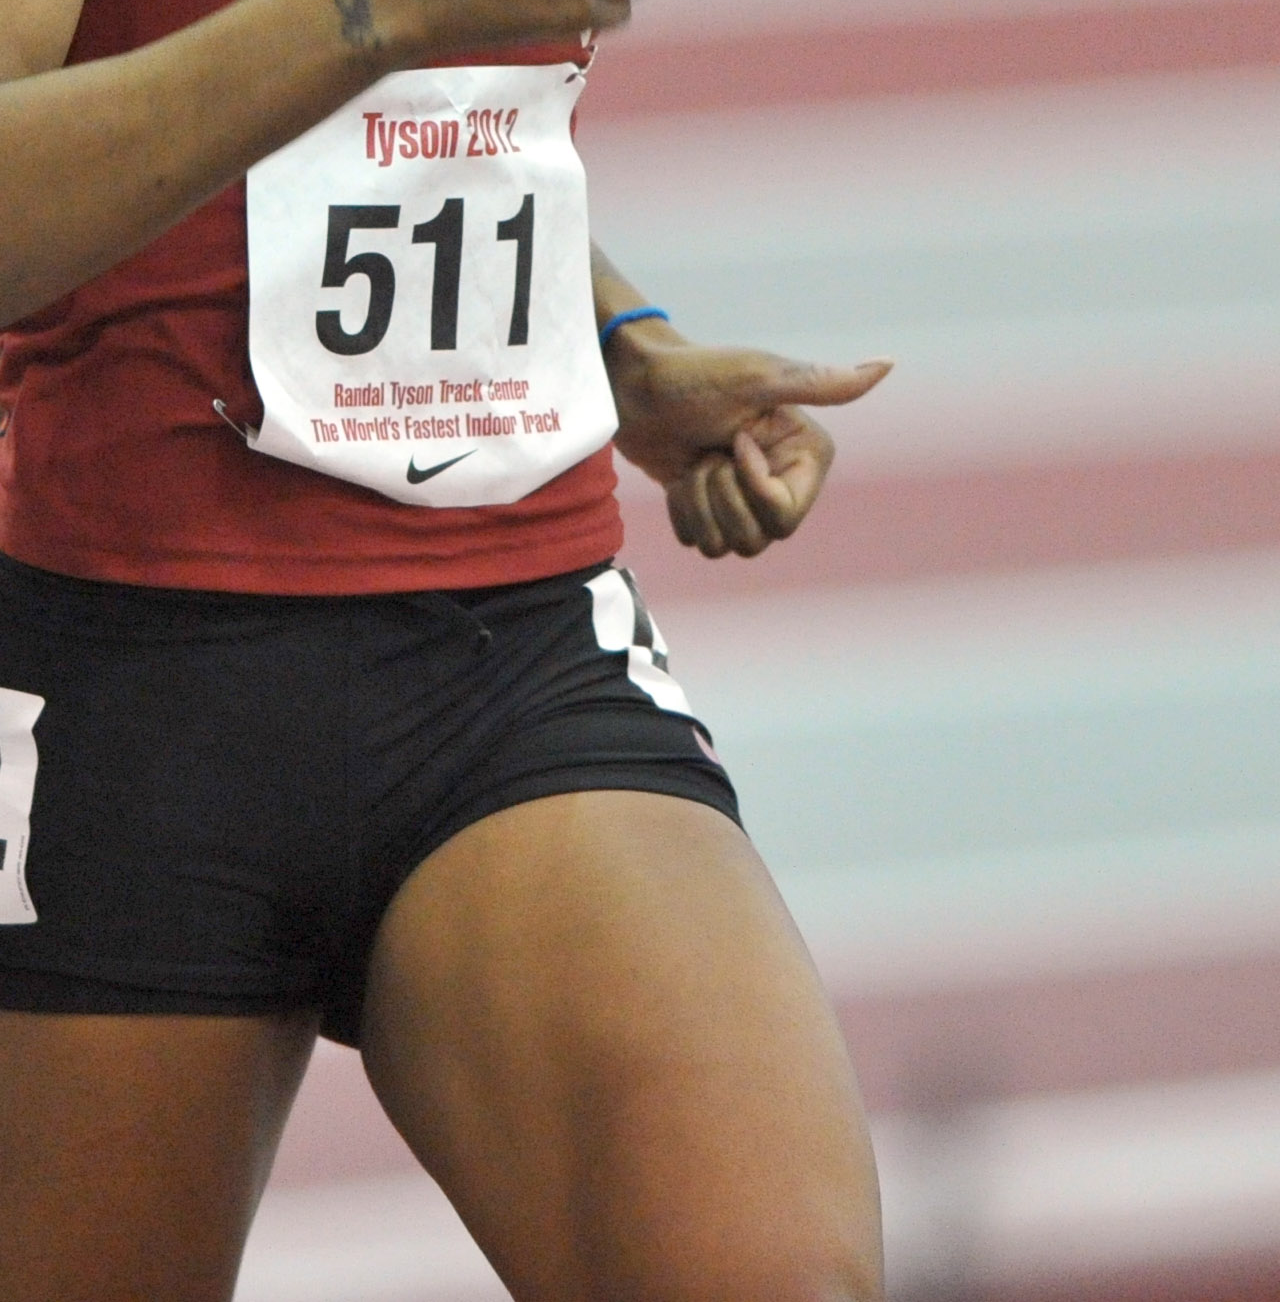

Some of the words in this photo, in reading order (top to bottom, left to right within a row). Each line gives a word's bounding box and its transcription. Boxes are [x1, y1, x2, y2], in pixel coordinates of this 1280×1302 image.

[362, 112, 459, 167] Tyson
[466, 108, 521, 157] 2012
[315, 193, 535, 356] 511
[334, 382, 385, 407] Randal
[390, 380, 434, 410] Tyson
[439, 378, 483, 404] Track
[488, 378, 529, 402] Center
[310, 418, 339, 442] The
[341, 416, 400, 441] World's
[404, 415, 461, 440] Fastest
[466, 412, 517, 437] Indoor
[520, 408, 561, 434] Track
